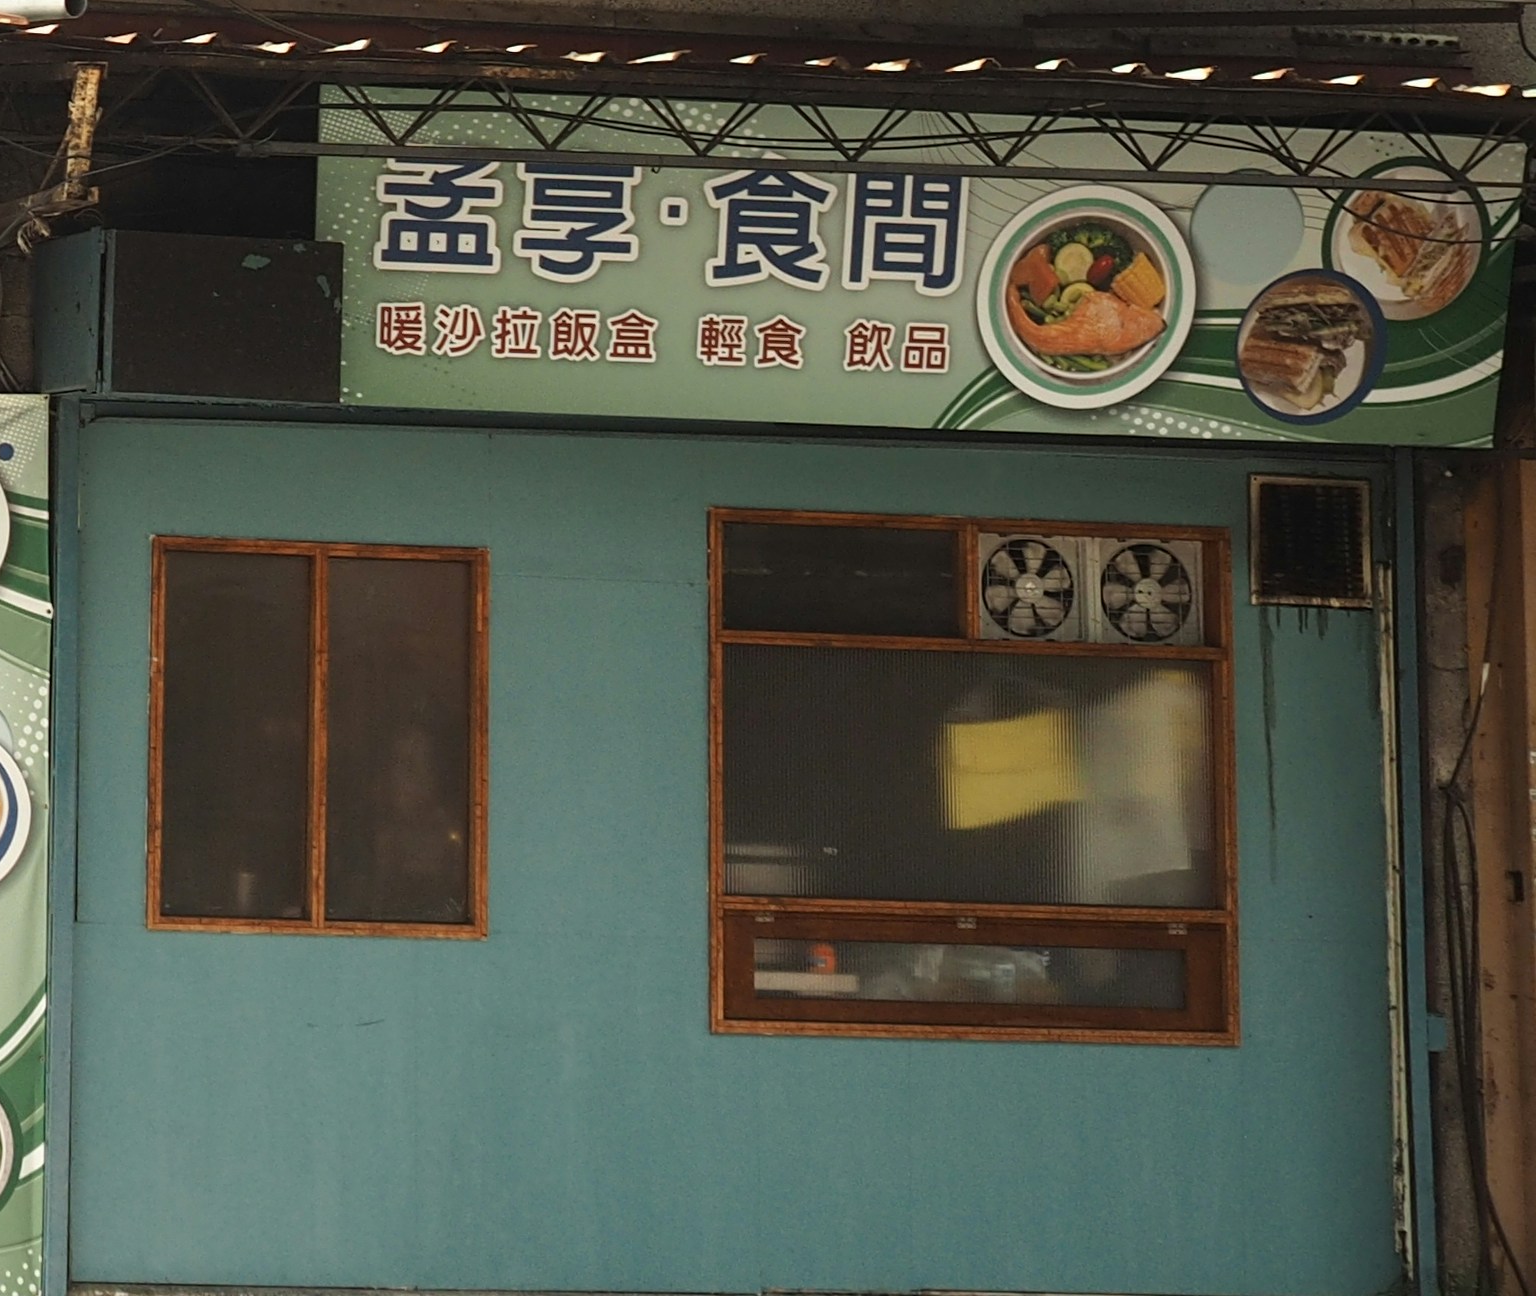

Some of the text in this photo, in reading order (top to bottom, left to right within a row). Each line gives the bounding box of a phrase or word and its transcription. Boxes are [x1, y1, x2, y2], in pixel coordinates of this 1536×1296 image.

[377, 301, 952, 375] 暖沙拉飯盒 輕食 飲品
